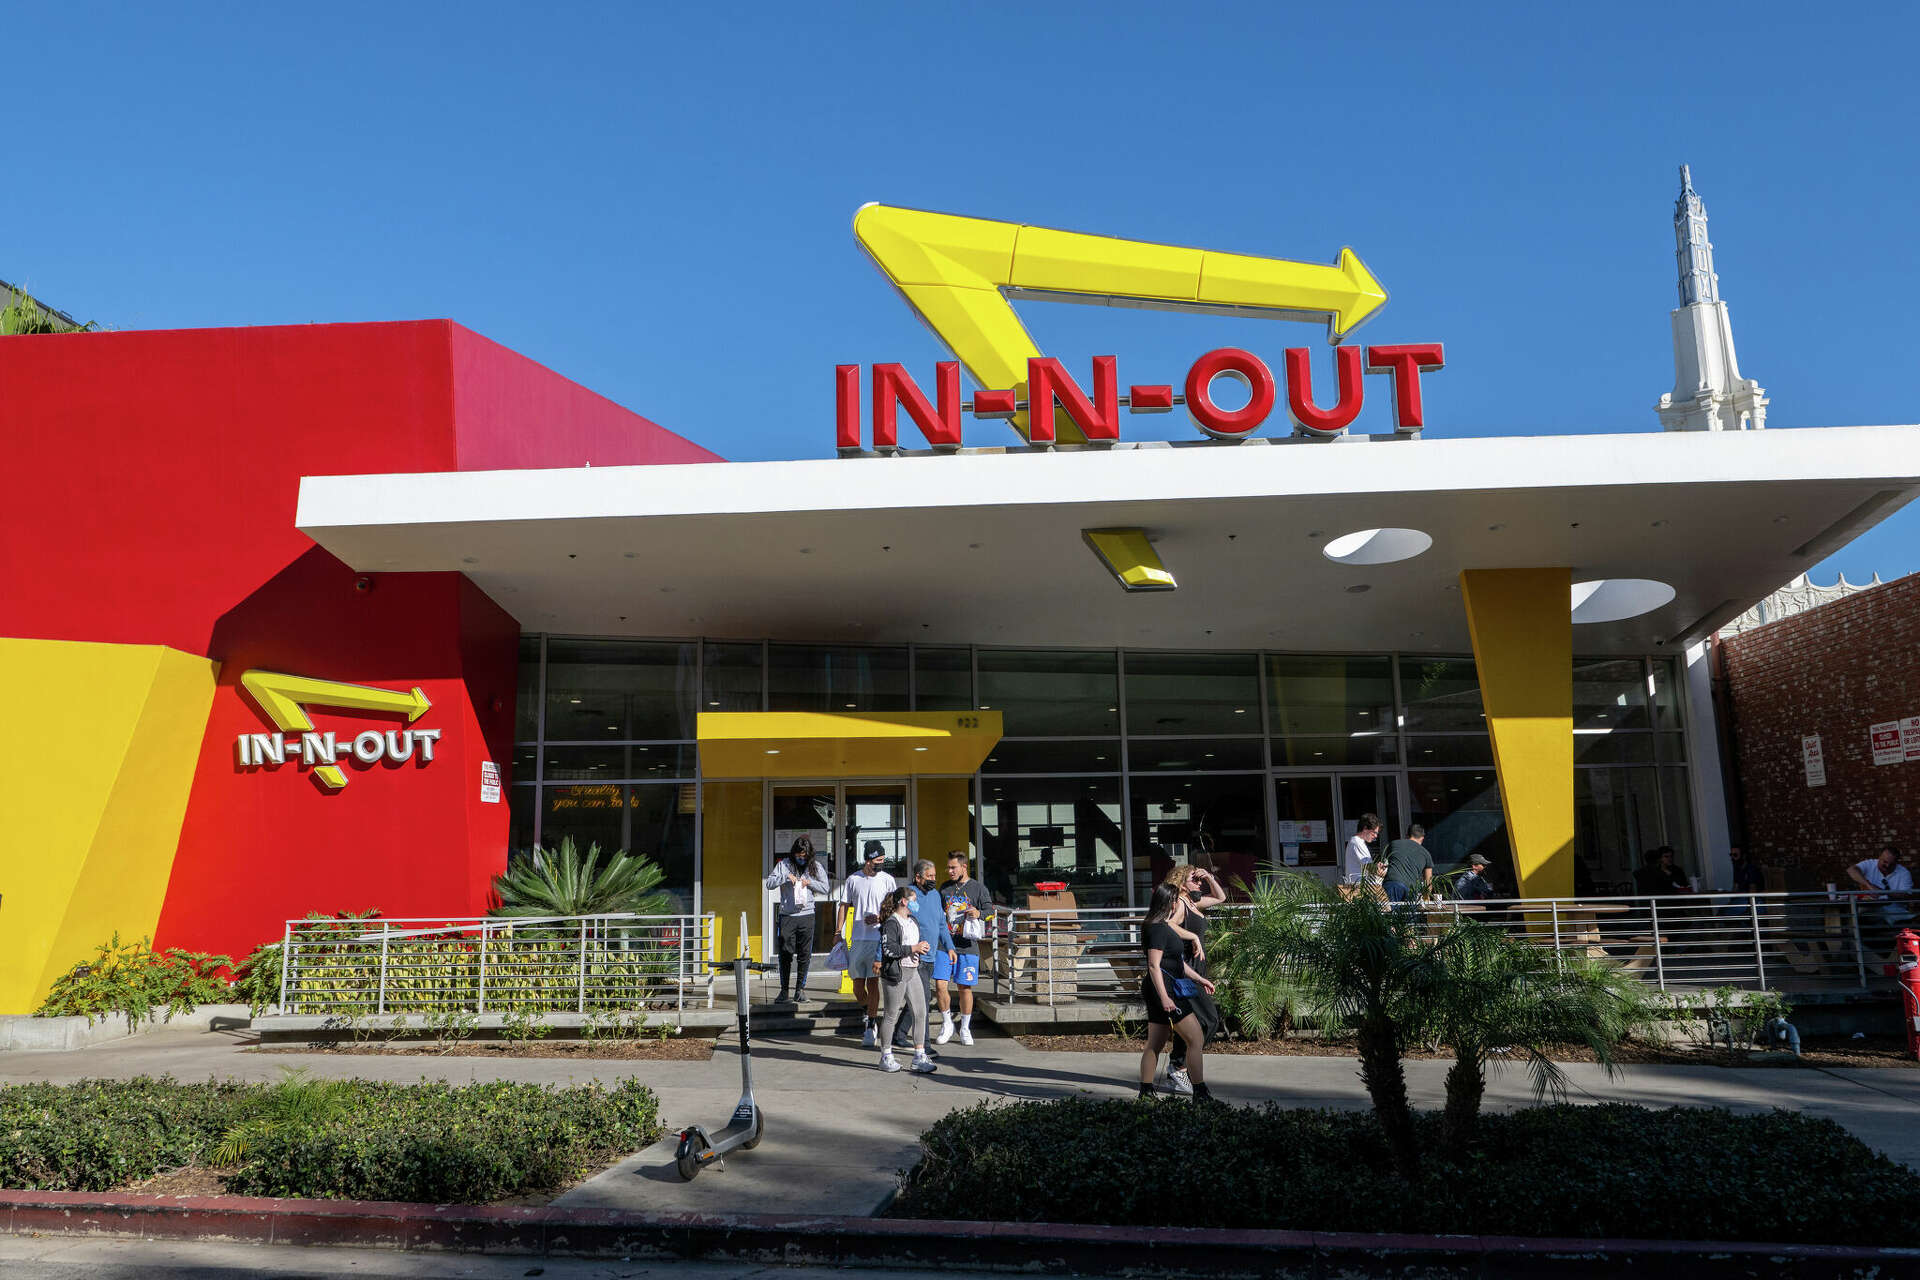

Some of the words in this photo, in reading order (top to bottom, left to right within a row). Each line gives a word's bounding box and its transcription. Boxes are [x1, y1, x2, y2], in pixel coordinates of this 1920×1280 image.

[835, 342, 1446, 450] IN-N-OUT
[237, 728, 442, 766] IN-N-OUT
[552, 799, 578, 812] you
